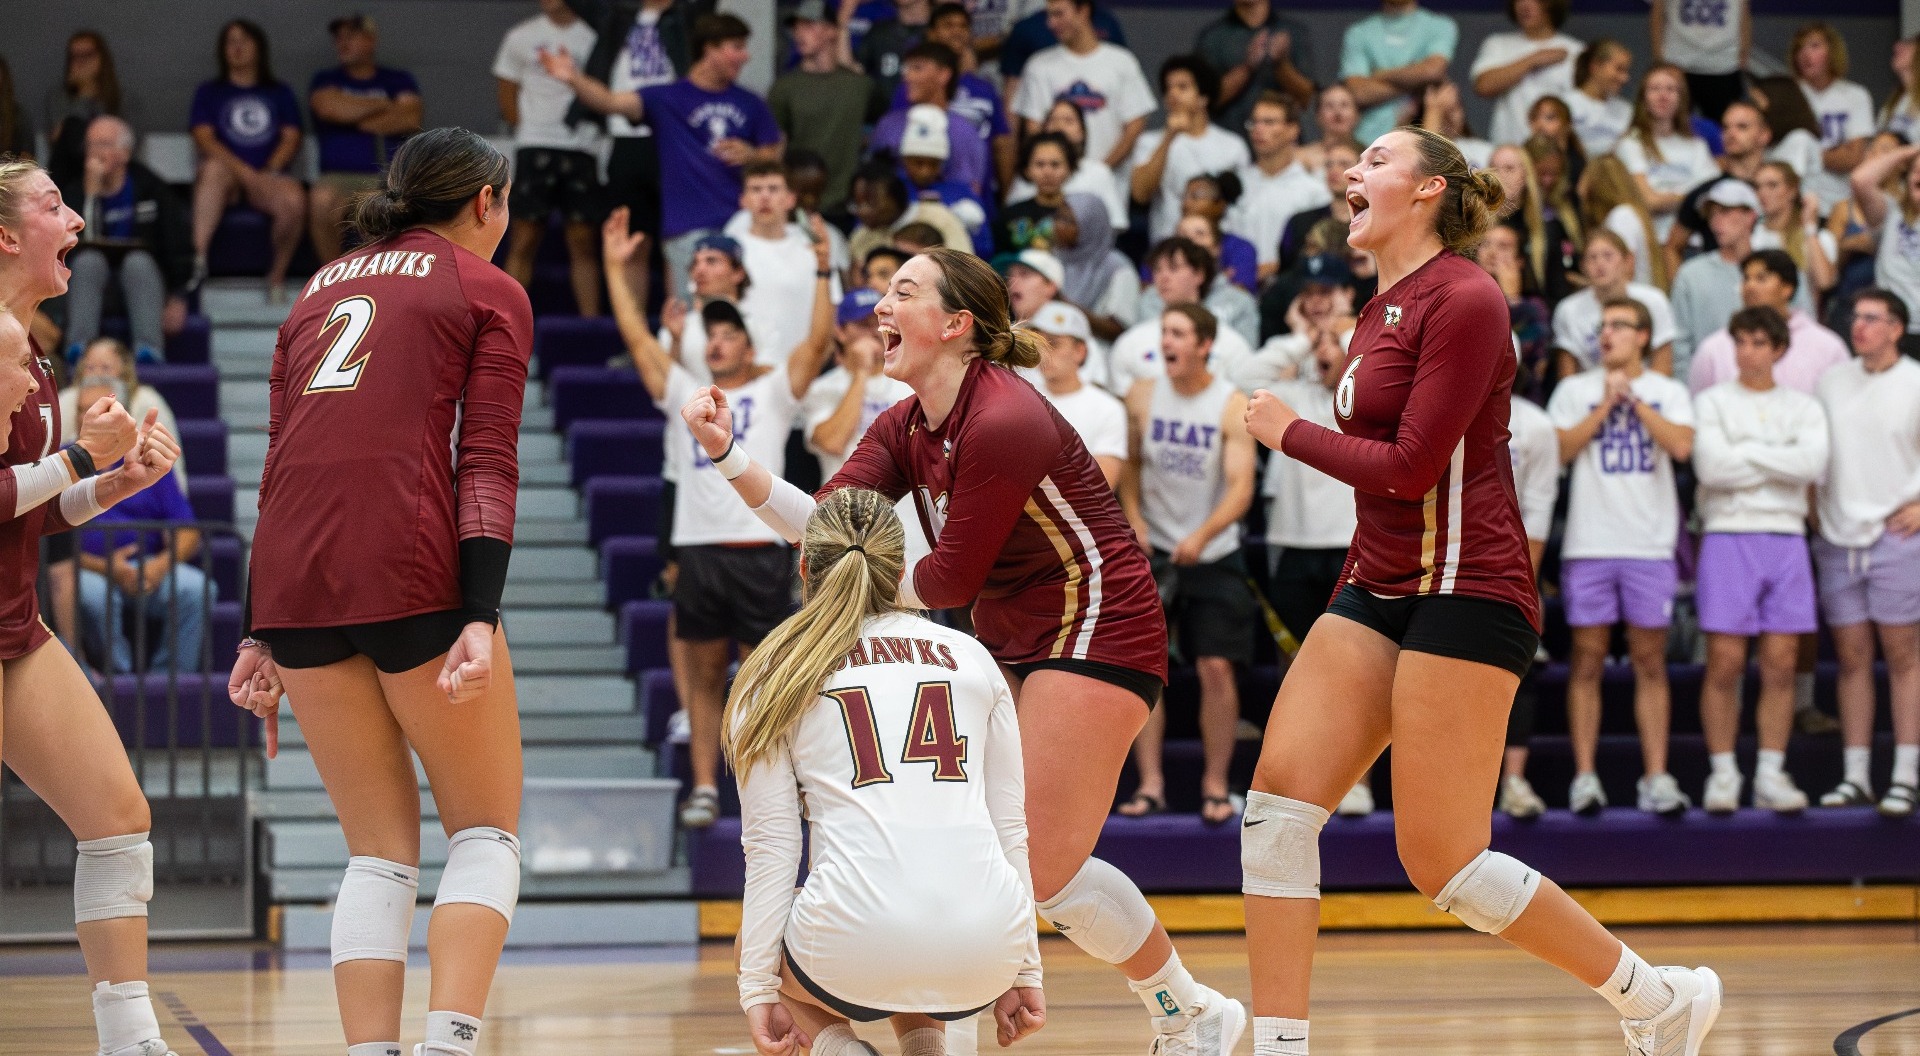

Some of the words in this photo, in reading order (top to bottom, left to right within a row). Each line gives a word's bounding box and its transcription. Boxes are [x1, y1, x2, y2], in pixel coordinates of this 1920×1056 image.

[302, 250, 437, 302] KOHAWKS
[302, 294, 377, 396] 2
[1336, 354, 1363, 420] 6
[1151, 418, 1217, 448] BEAT
[1601, 442, 1655, 473] COE
[832, 632, 959, 672] HAWKS
[818, 680, 968, 790] 14
